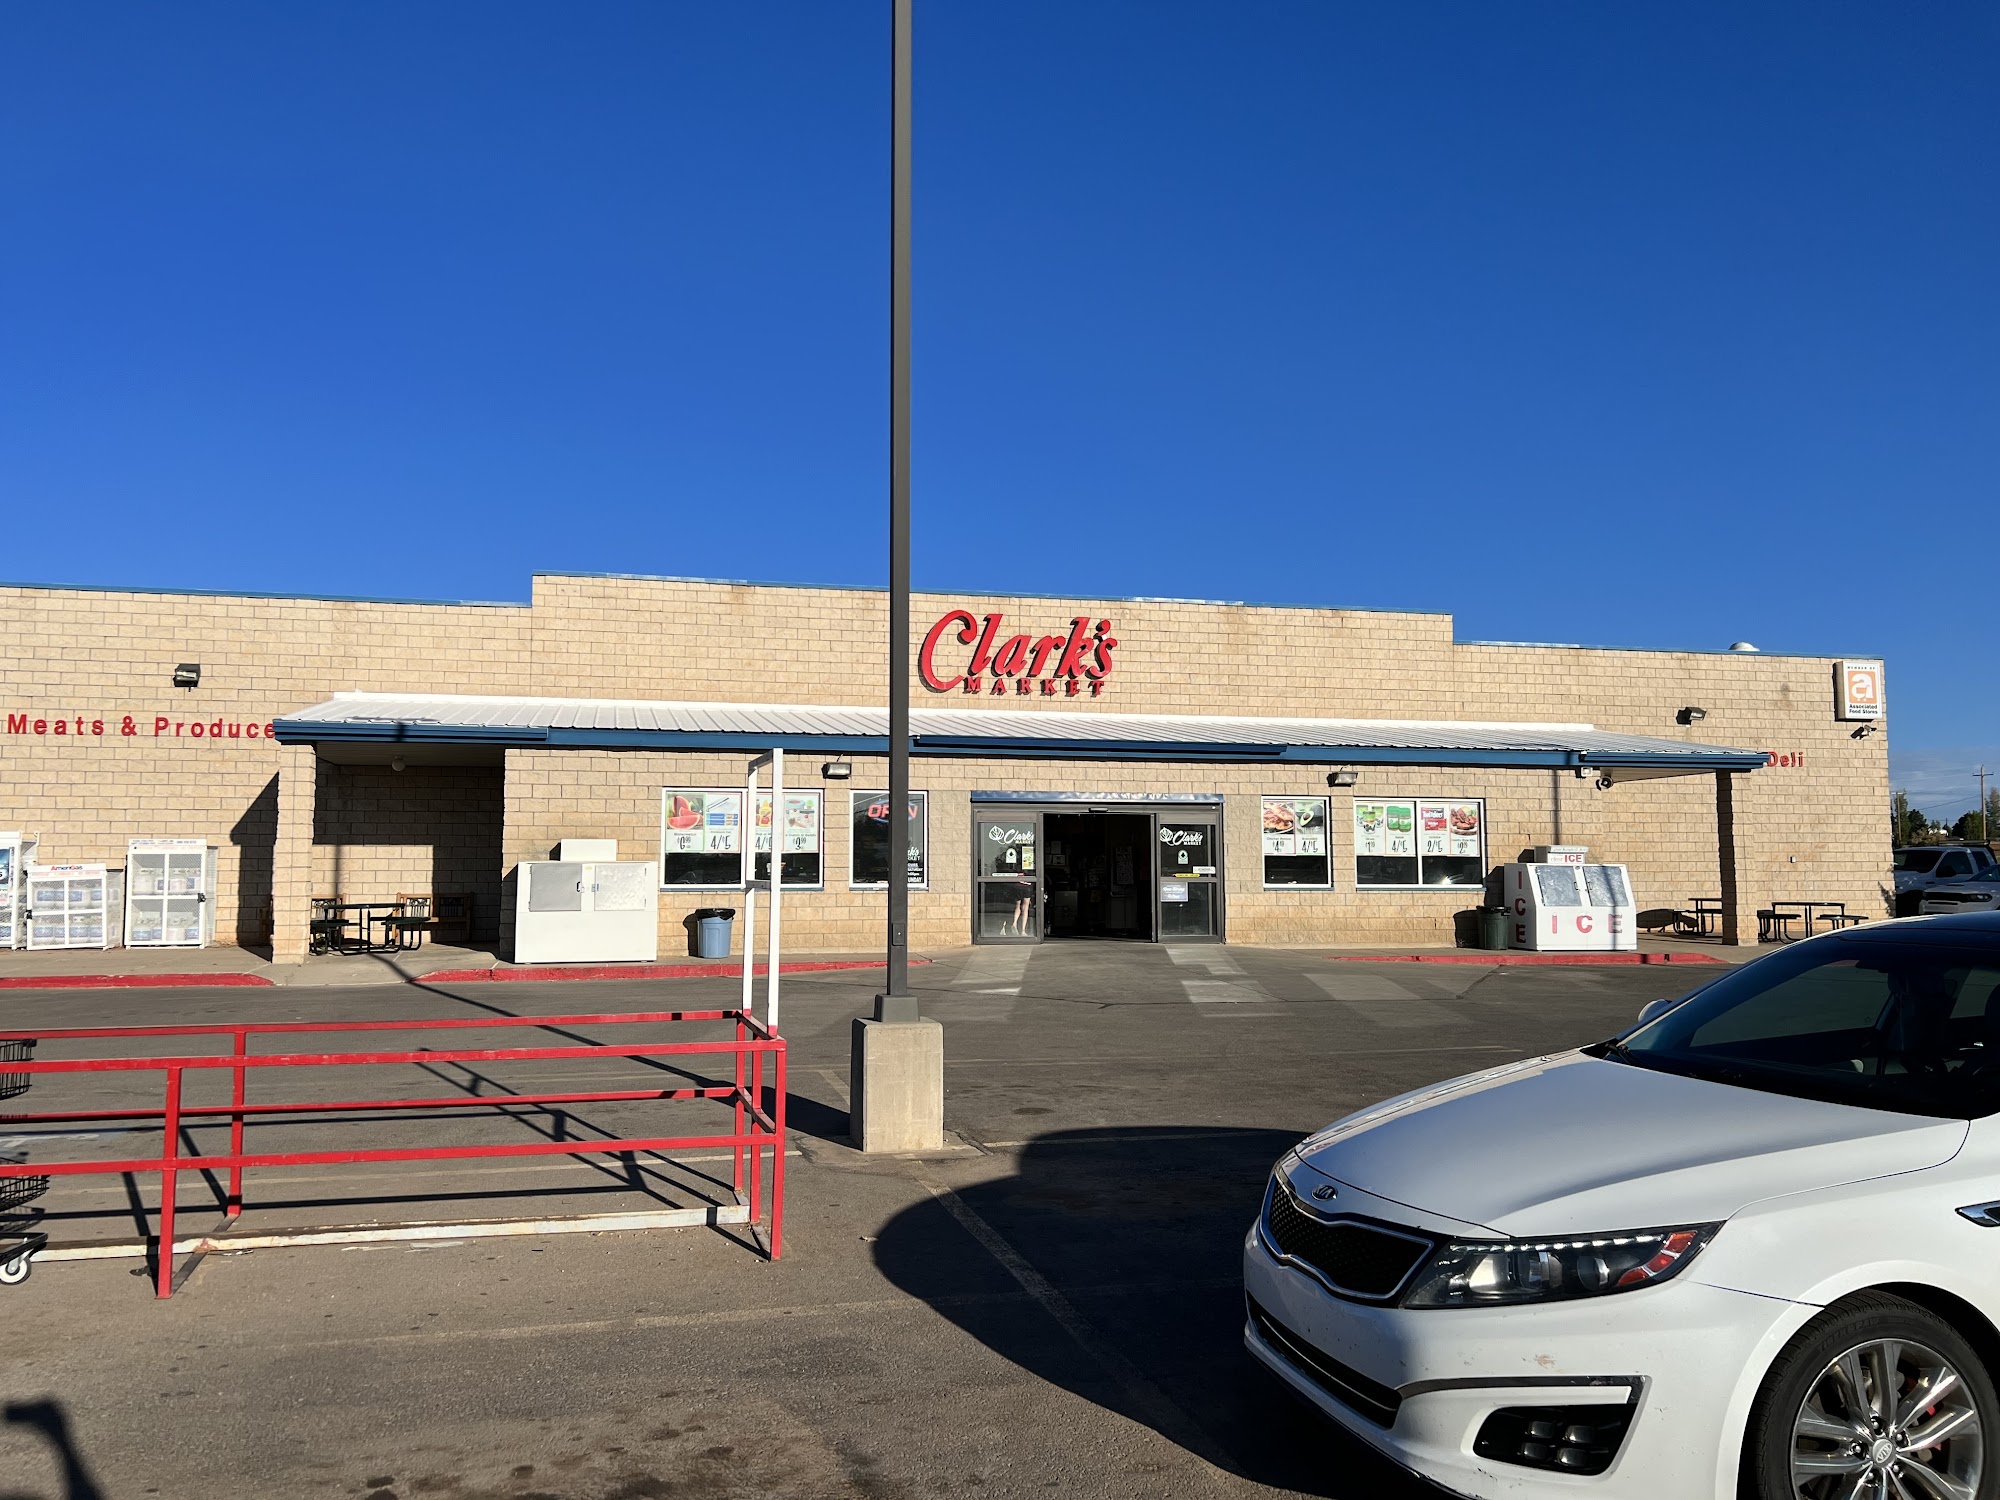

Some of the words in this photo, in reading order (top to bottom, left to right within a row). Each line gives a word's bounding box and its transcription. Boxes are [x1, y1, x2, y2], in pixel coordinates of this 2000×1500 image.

[919, 609, 1118, 690] Clark's
[965, 676, 1105, 695] MARKET
[7, 714, 104, 736] Meats
[121, 715, 138, 736] &
[154, 717, 276, 739] Produce
[1767, 750, 1804, 768] Deli
[868, 804, 918, 819] OPN
[1173, 830, 1203, 845] Clark's
[1564, 854, 1582, 862] ICE
[1514, 871, 1526, 944] ICE
[1551, 913, 1623, 934] ICE
